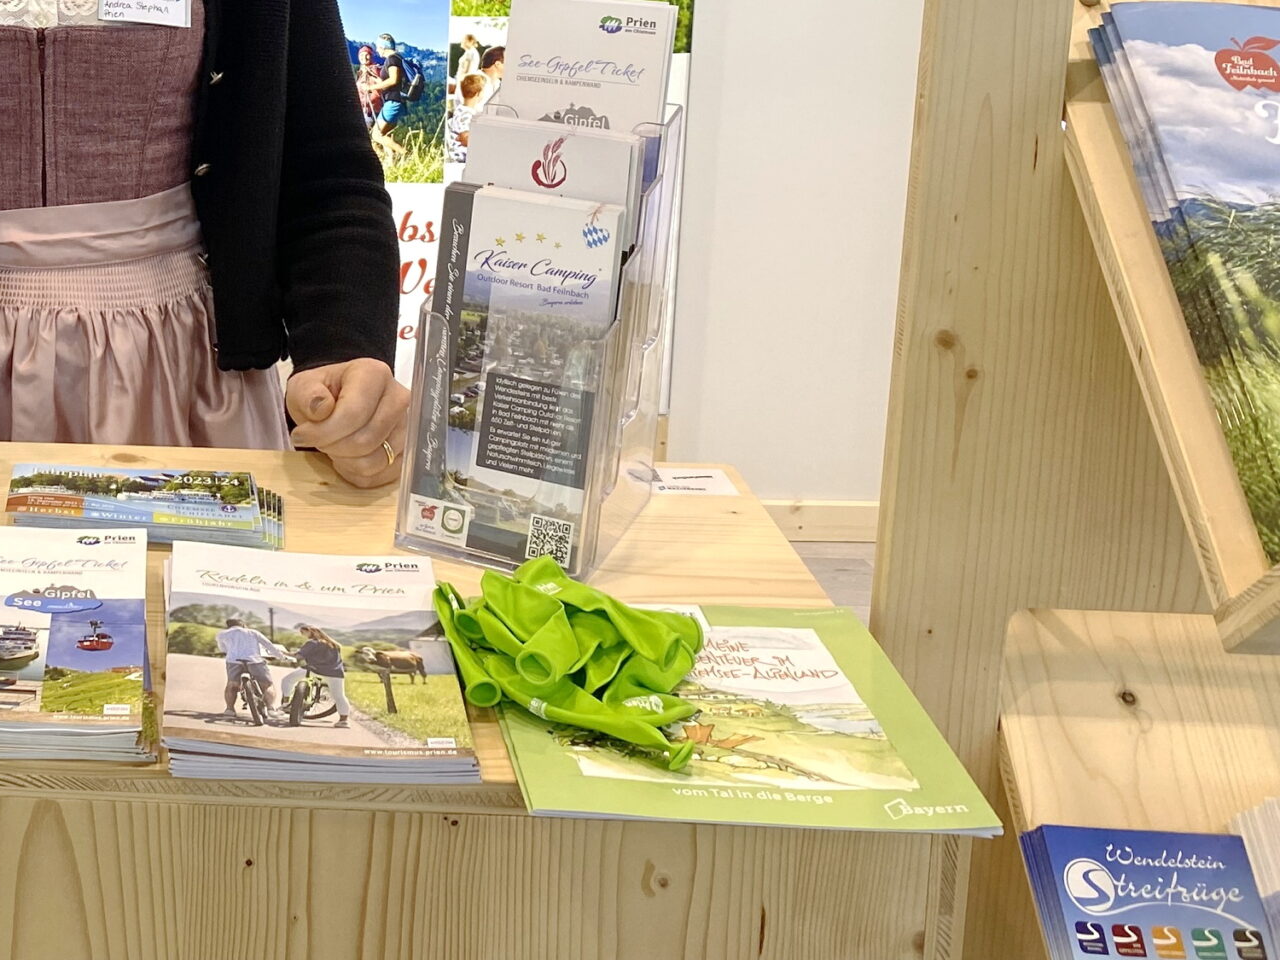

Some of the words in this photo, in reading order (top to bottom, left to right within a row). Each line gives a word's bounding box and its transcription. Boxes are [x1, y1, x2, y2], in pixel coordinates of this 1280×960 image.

[625, 16, 657, 29] Prien
[1230, 55, 1253, 67] Bad
[1221, 62, 1278, 76] Feilnbach
[473, 249, 528, 273] Kaiser
[529, 258, 599, 290] Camping
[477, 273, 509, 286] Outdoor
[509, 278, 534, 290] Resort
[536, 283, 552, 294] Bad
[552, 286, 590, 300] Feilnbach
[510, 404, 538, 416] Camping
[28, 506, 76, 517] Herbst
[100, 511, 148, 521] Winter
[384, 562, 419, 570] Prien
[195, 568, 267, 586] Radeln
[293, 581, 314, 591] &
[320, 585, 346, 594] um
[351, 583, 407, 595] Prien
[44, 589, 92, 600] Gipfel
[13, 597, 42, 607] See
[363, 748, 458, 756] www.tourismus.prien.de
[672, 787, 708, 797] vom
[711, 788, 734, 798] Tal
[736, 789, 753, 799] in
[755, 790, 782, 800] die
[784, 791, 834, 804] Berge
[899, 802, 969, 817] Bayern
[1105, 843, 1227, 870] Wendelstein
[1070, 862, 1245, 914] Streifzüge
